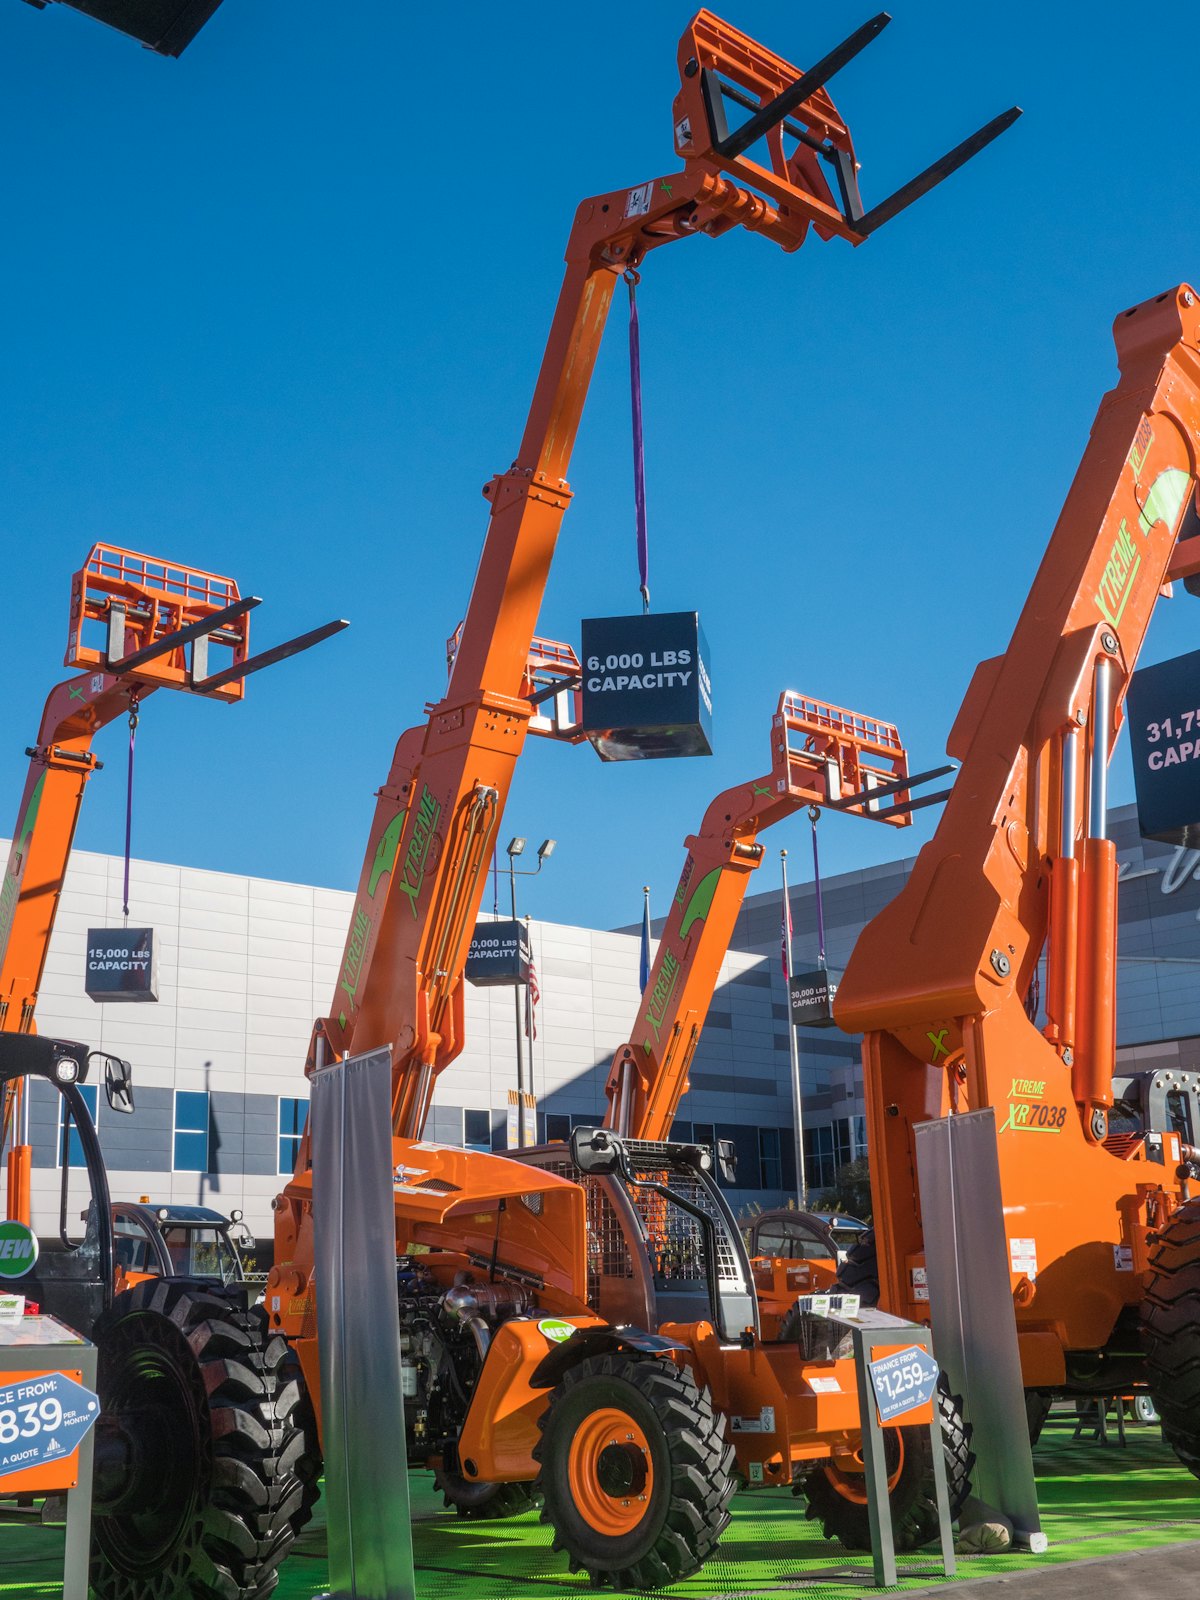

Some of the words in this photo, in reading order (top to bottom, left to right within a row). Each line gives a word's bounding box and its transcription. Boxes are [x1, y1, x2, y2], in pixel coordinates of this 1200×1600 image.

[1094, 515, 1142, 630] XTREME
[587, 653, 644, 674] 6,000
[650, 650, 692, 667] LBS
[587, 671, 692, 692] CAPACITY
[400, 783, 441, 921] XTREME
[88, 948, 129, 960] 15,000
[131, 950, 151, 958] LBS
[469, 939, 499, 950] 0,000
[501, 939, 518, 947] LBS
[88, 961, 149, 971] CAPACITY
[341, 903, 372, 1013] XTREME
[645, 947, 680, 1043] XTREME
[791, 988, 815, 999] 30,000
[815, 986, 827, 994] LBS
[792, 995, 827, 1008] CAPACITY
[1006, 1078, 1047, 1099] XTREME
[873, 1358, 900, 1375] FINANCE
[18, 1380, 57, 1401] FROM:
[876, 1362, 923, 1400] $1,259
[63, 1410, 77, 1420] PER
[2, 1456, 9, 1465] A
[10, 1448, 40, 1463] QUOTE
